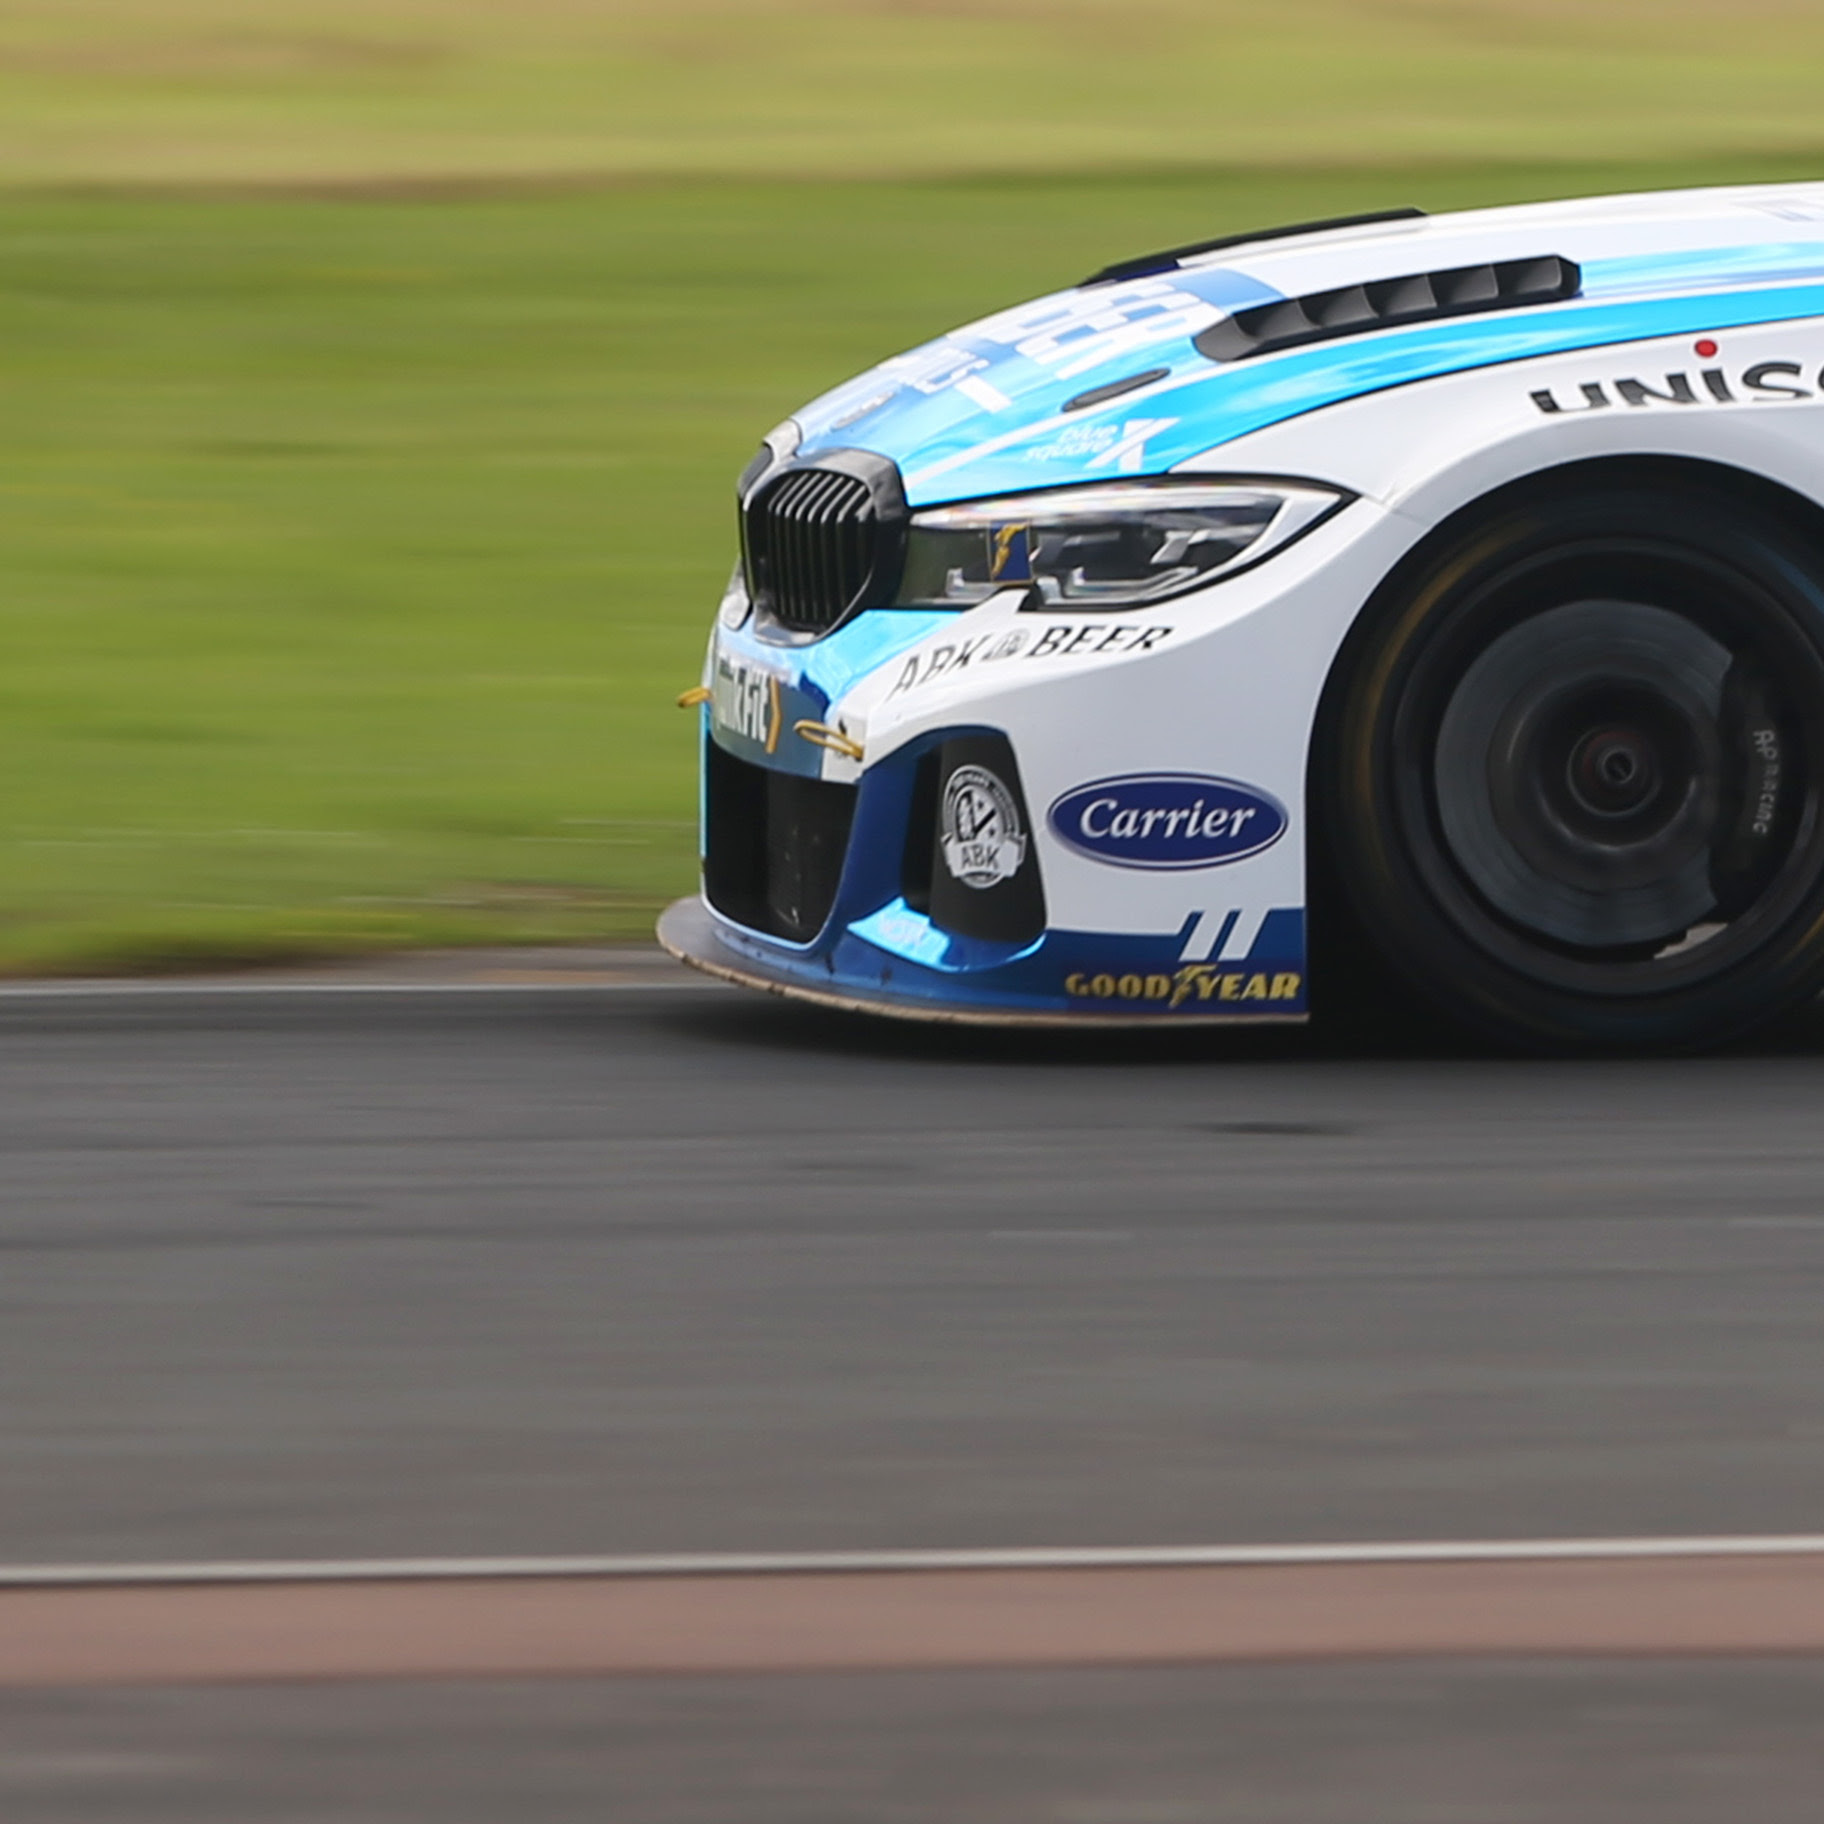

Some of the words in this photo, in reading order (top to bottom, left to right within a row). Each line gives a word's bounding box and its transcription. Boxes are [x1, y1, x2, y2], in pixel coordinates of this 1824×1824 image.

[885, 634, 990, 703] ABK
[1023, 625, 1174, 658] BEER
[1080, 798, 1257, 840] Carrier
[961, 843, 1000, 870] ABK
[1064, 963, 1300, 1008] GOODYEAR
